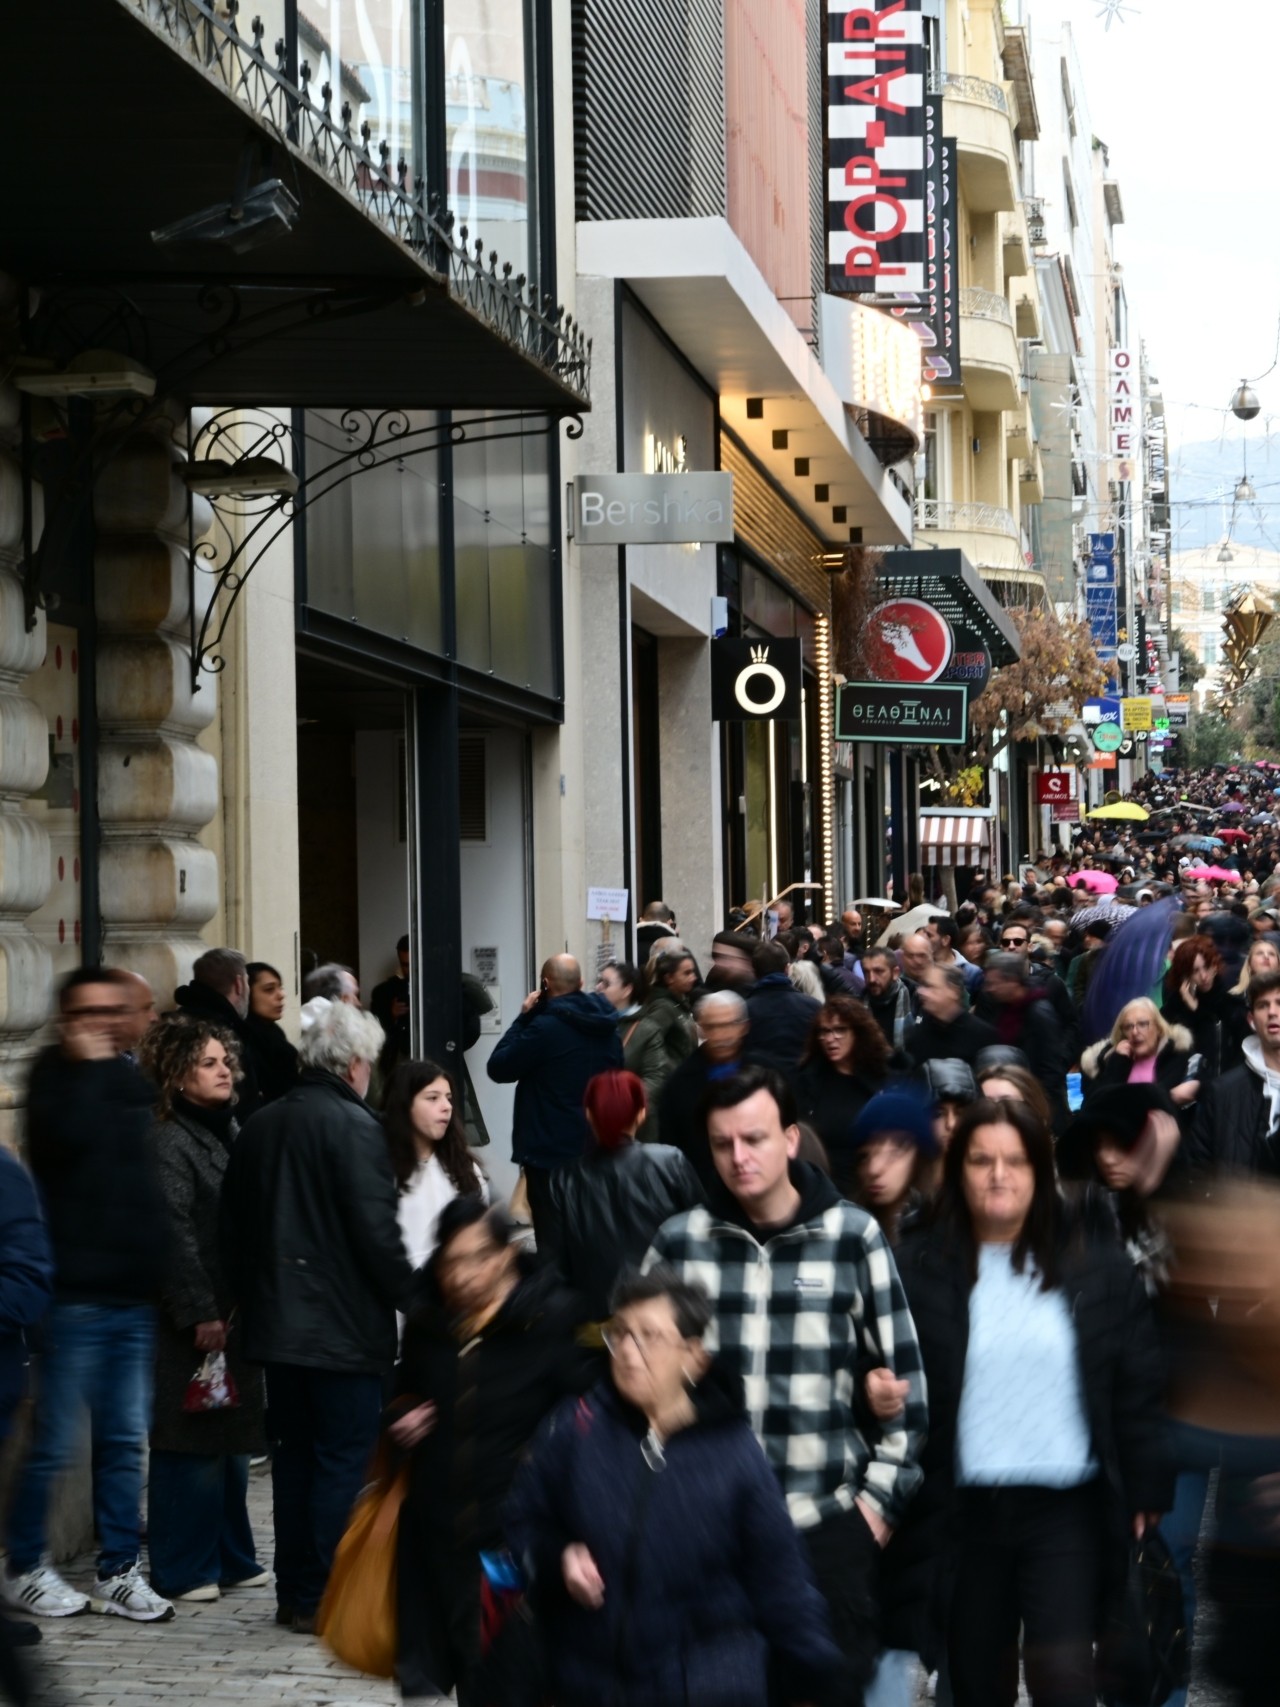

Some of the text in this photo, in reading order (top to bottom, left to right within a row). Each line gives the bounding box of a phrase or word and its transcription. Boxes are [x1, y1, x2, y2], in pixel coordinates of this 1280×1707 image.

[844, 0, 907, 277] POP-AIR
[581, 490, 723, 526] Bershka
[950, 652, 985, 665] TER
[945, 665, 985, 679] PORT
